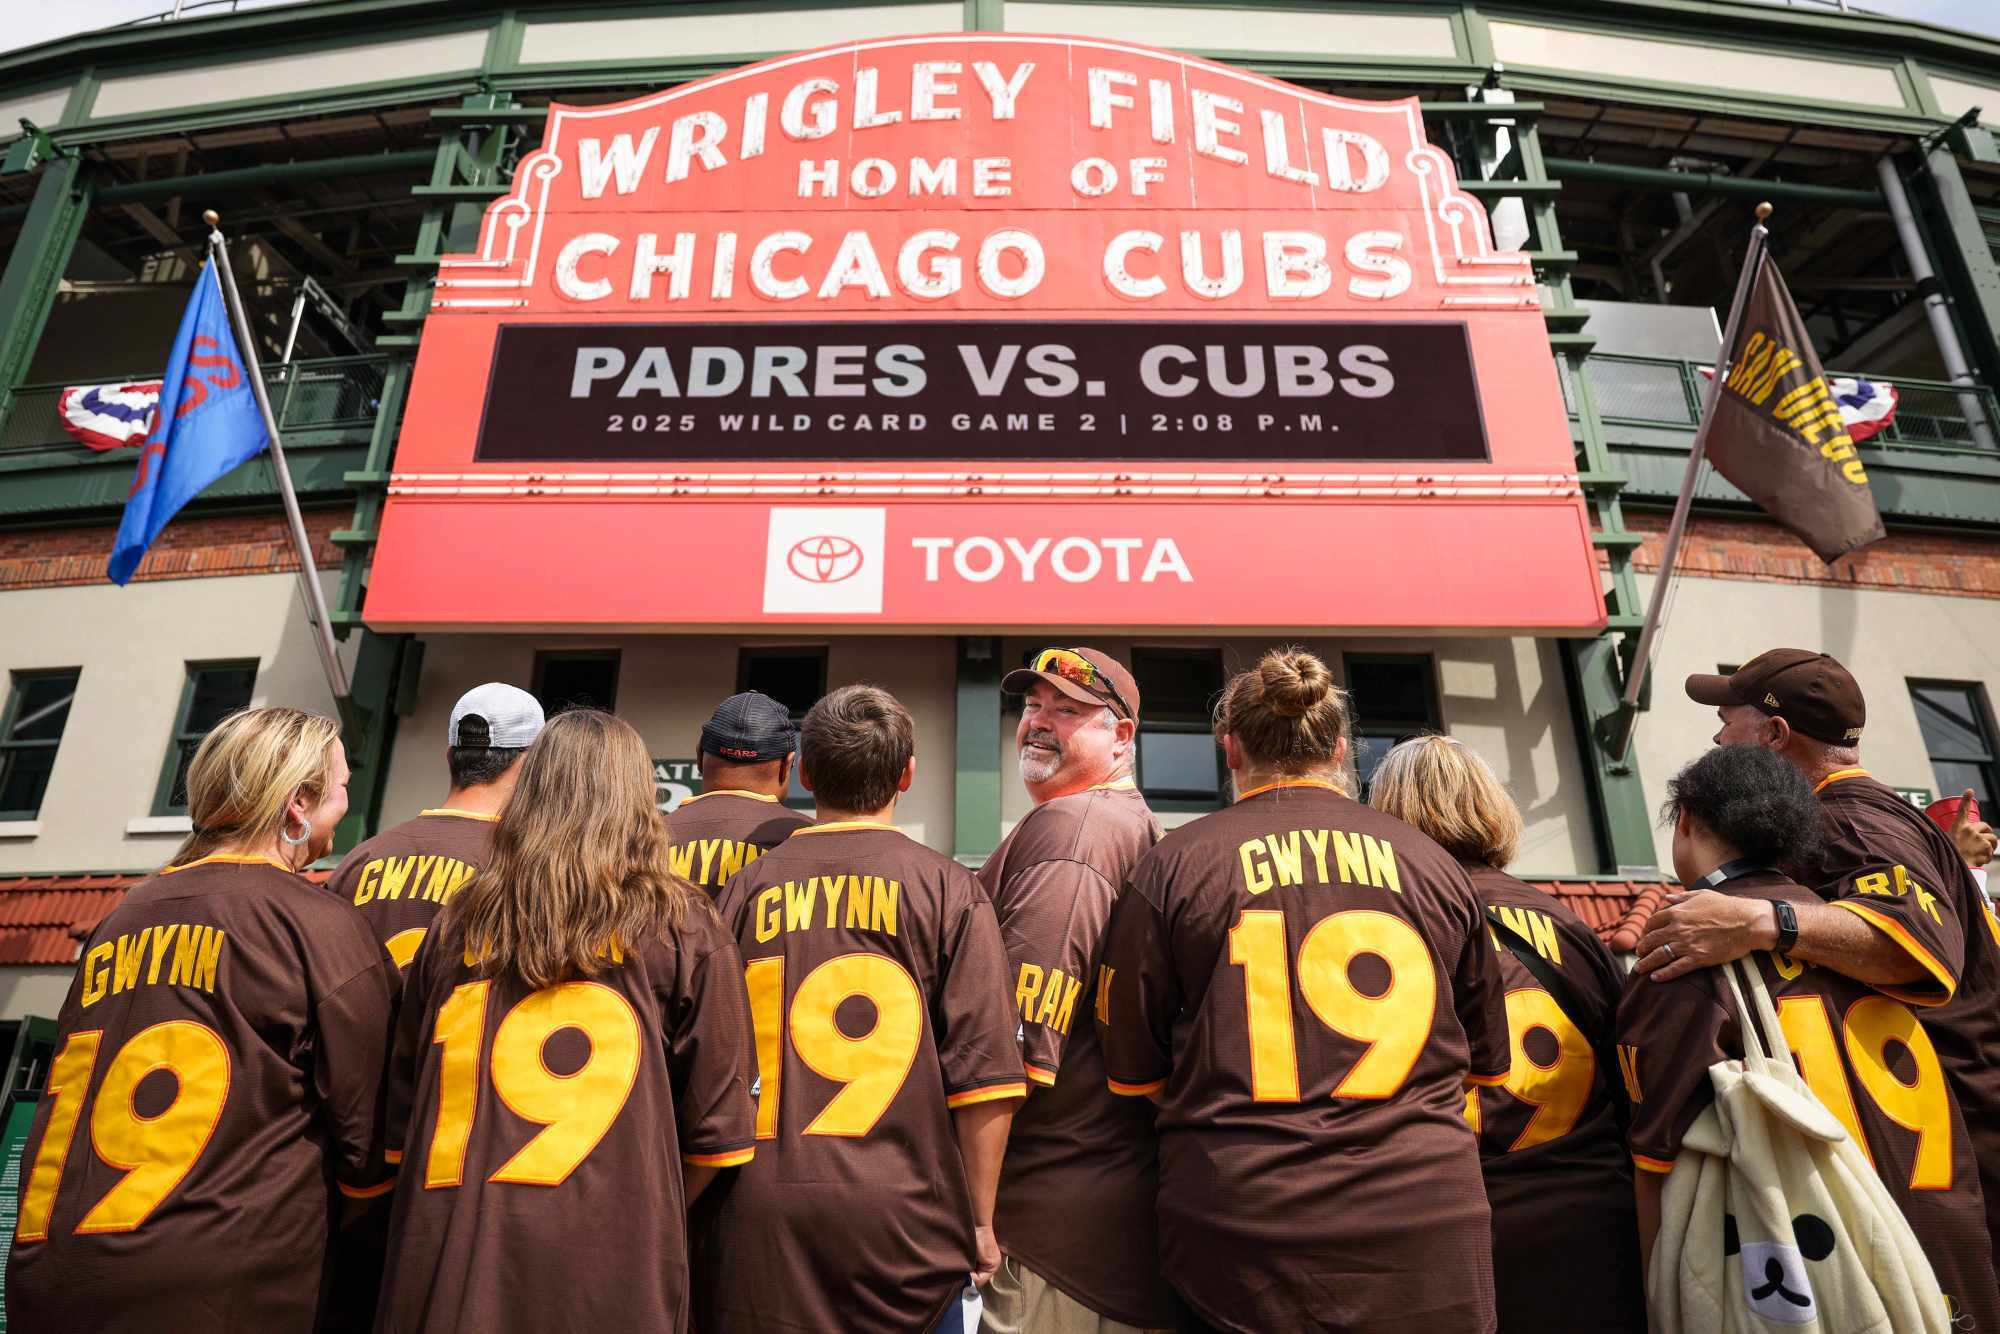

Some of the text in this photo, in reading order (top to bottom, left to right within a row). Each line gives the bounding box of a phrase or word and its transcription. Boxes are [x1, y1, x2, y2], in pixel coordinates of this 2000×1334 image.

[578, 61, 1390, 199] WRIGLEY FIELD
[798, 157, 1167, 197] HOME OF
[555, 229, 1412, 301] CHICAGO CUBS
[570, 344, 1395, 398] PADRES VS. CUBS
[1727, 331, 1868, 485] SAN DIEGO
[607, 415, 695, 432] 2025
[719, 414, 811, 431] WILD
[827, 414, 927, 431] CARD
[952, 413, 1055, 431] GAME
[1080, 414, 1096, 431] 2
[1152, 414, 1233, 431] 2:08
[1258, 414, 1340, 432] P.M.
[912, 536, 1194, 582] TOYOTA
[655, 763, 703, 780] ATE
[1238, 829, 1402, 895] GWYNN
[756, 875, 900, 944] GWYNN
[81, 923, 225, 1008] GWYNN
[1015, 962, 1083, 1036] RAK
[1228, 909, 1437, 1103] 19
[745, 952, 923, 1139] 19
[424, 979, 642, 1190] 19
[1776, 994, 1953, 1191] 19
[15, 1019, 231, 1244] 19
